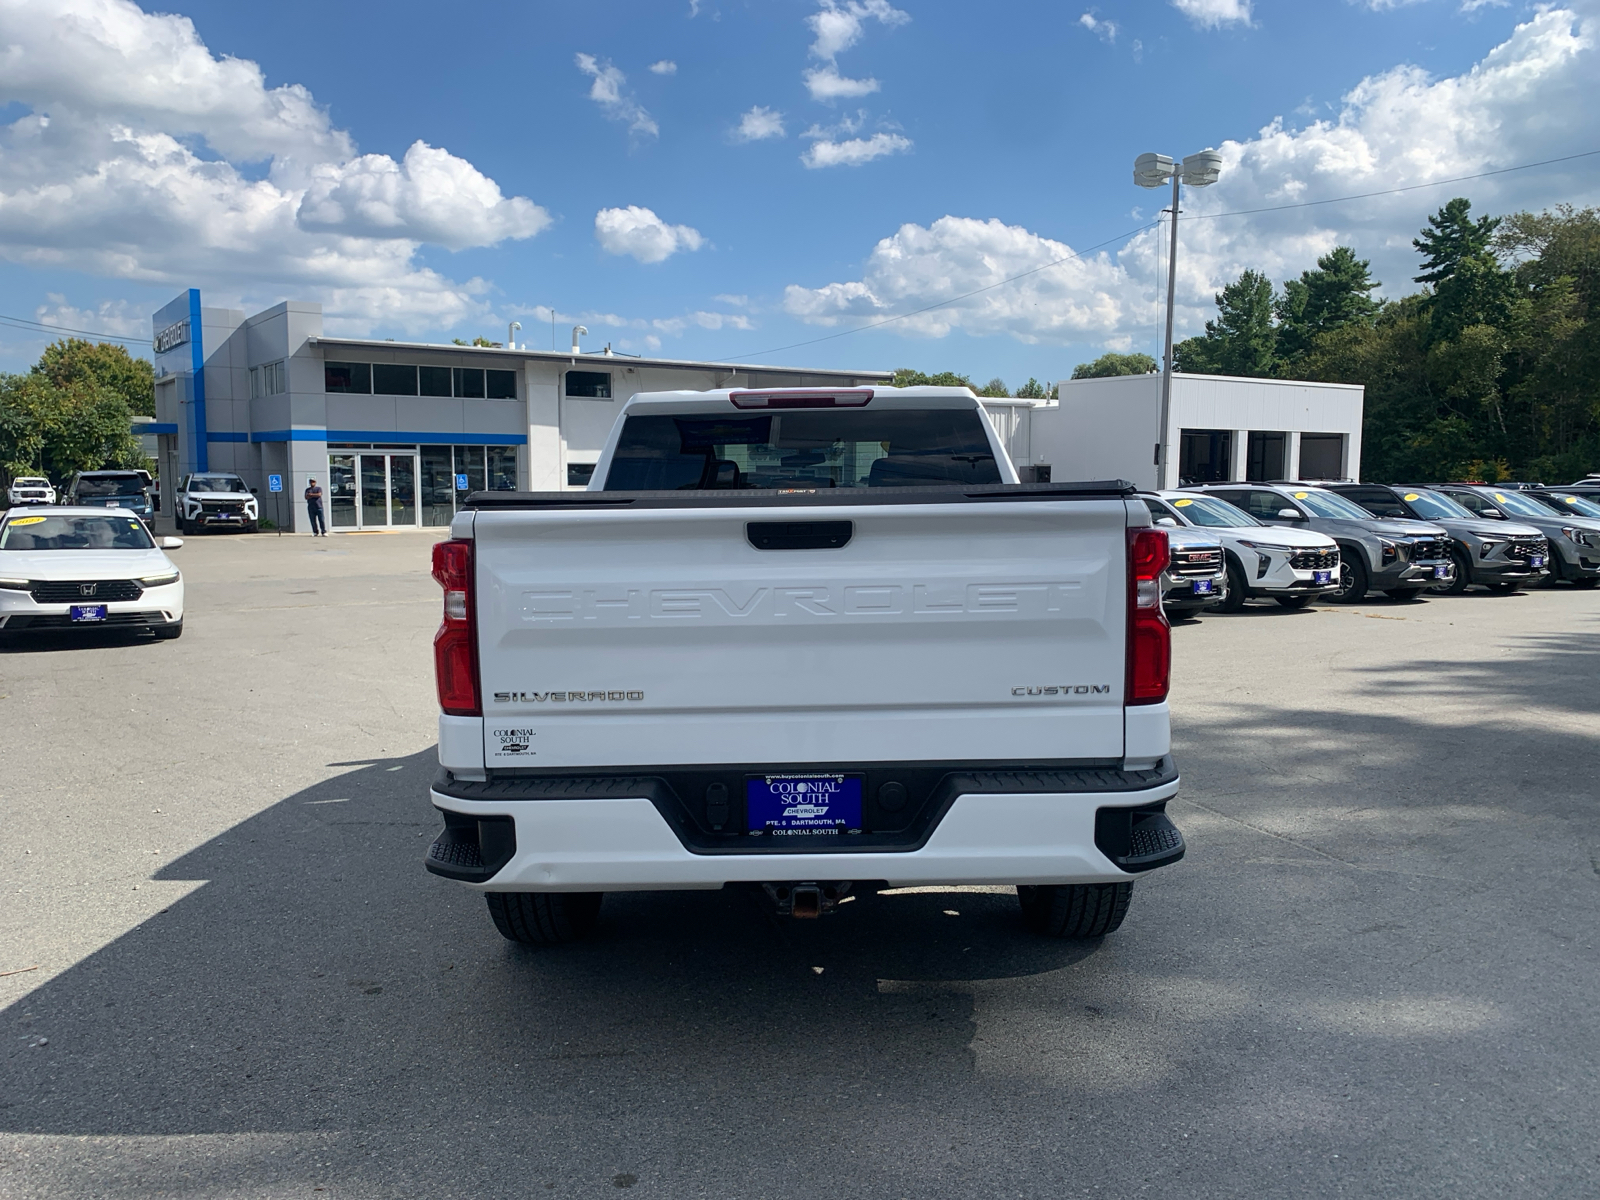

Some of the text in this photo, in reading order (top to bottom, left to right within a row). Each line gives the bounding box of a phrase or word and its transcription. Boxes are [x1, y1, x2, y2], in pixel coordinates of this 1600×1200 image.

[520, 580, 1082, 623] CHEVROLET
[493, 690, 644, 703] SILVERADO
[1011, 684, 1110, 697] CUSTOM
[493, 729, 537, 737] COLONIAL
[500, 736, 530, 744] SOUTH
[769, 782, 841, 794] COLONIAL
[781, 793, 830, 805] SOUTH
[812, 828, 839, 836] SOUTH
